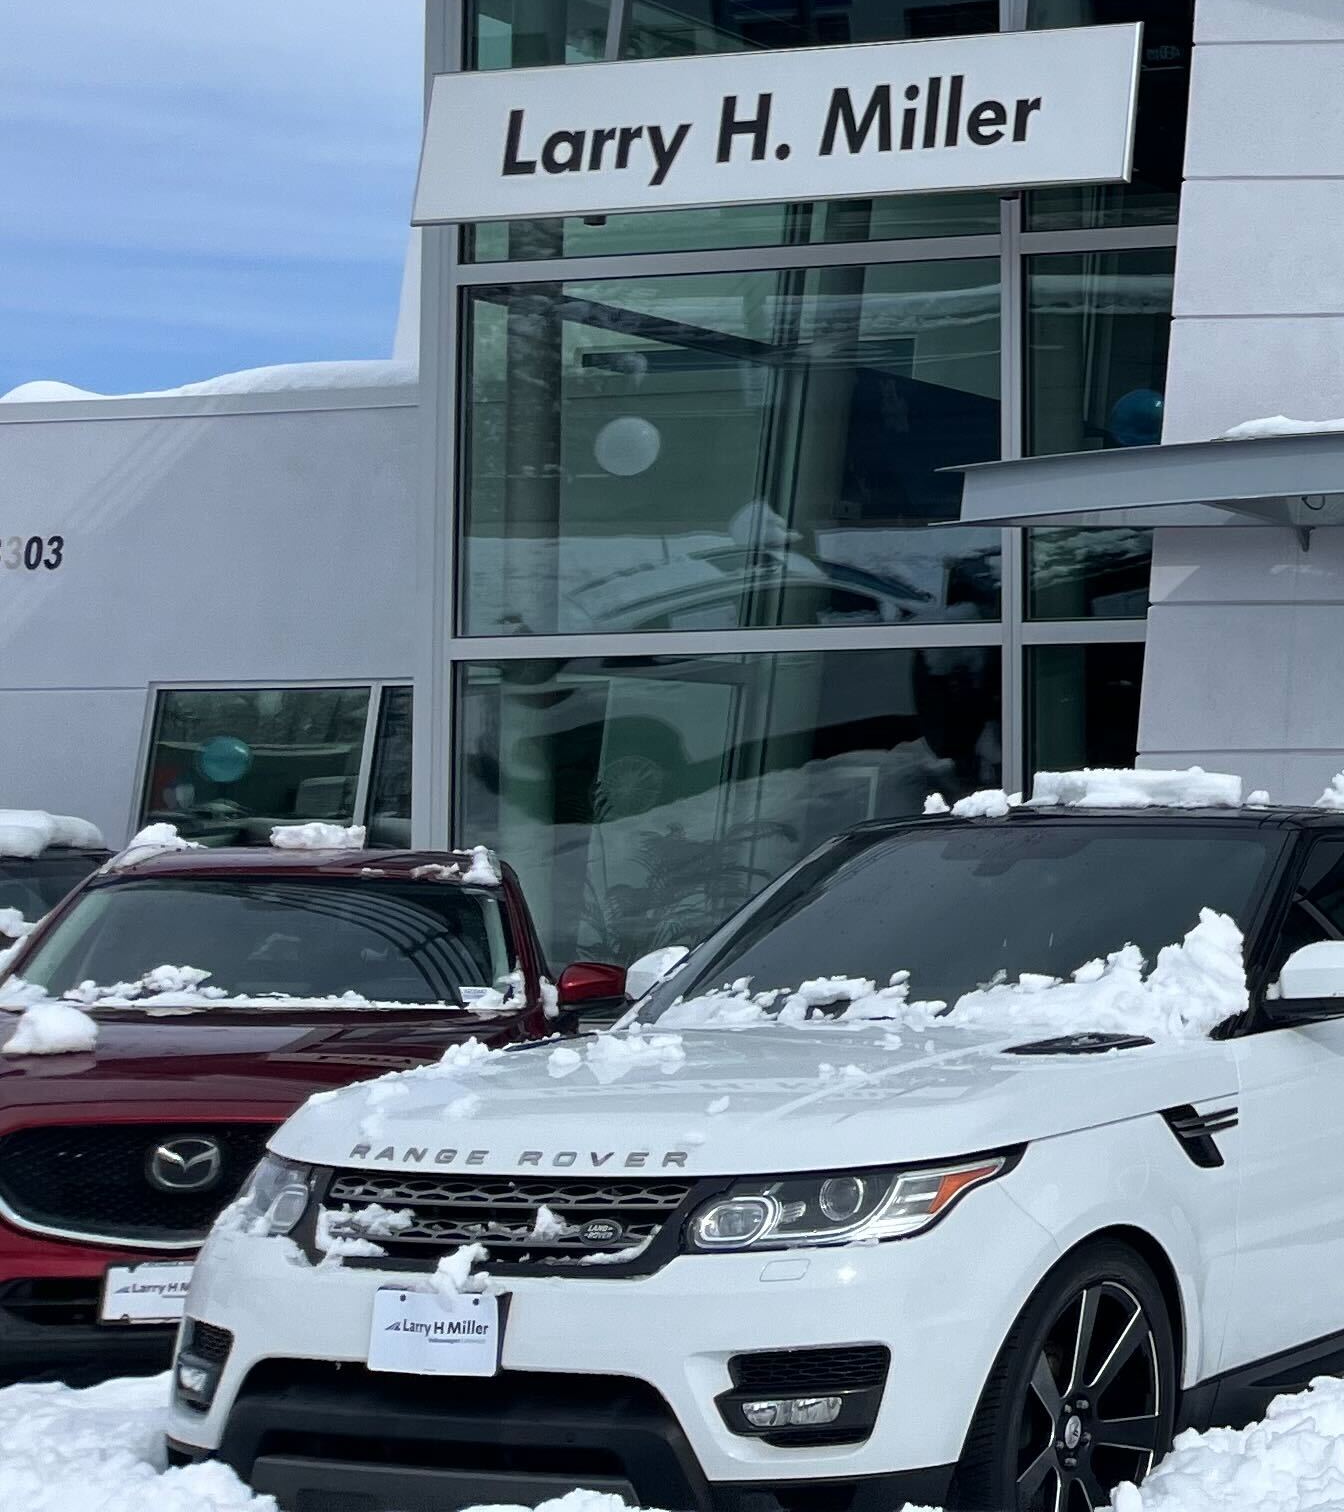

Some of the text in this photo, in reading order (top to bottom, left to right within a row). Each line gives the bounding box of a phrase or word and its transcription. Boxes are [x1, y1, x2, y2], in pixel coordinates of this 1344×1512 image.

[503, 75, 1041, 185] Larry H. Miller
[0, 535, 64, 571] 303
[350, 1144, 689, 1168] RANGE ROVER
[132, 1283, 166, 1295] Larry
[402, 1318, 489, 1337] Larry H Miller
